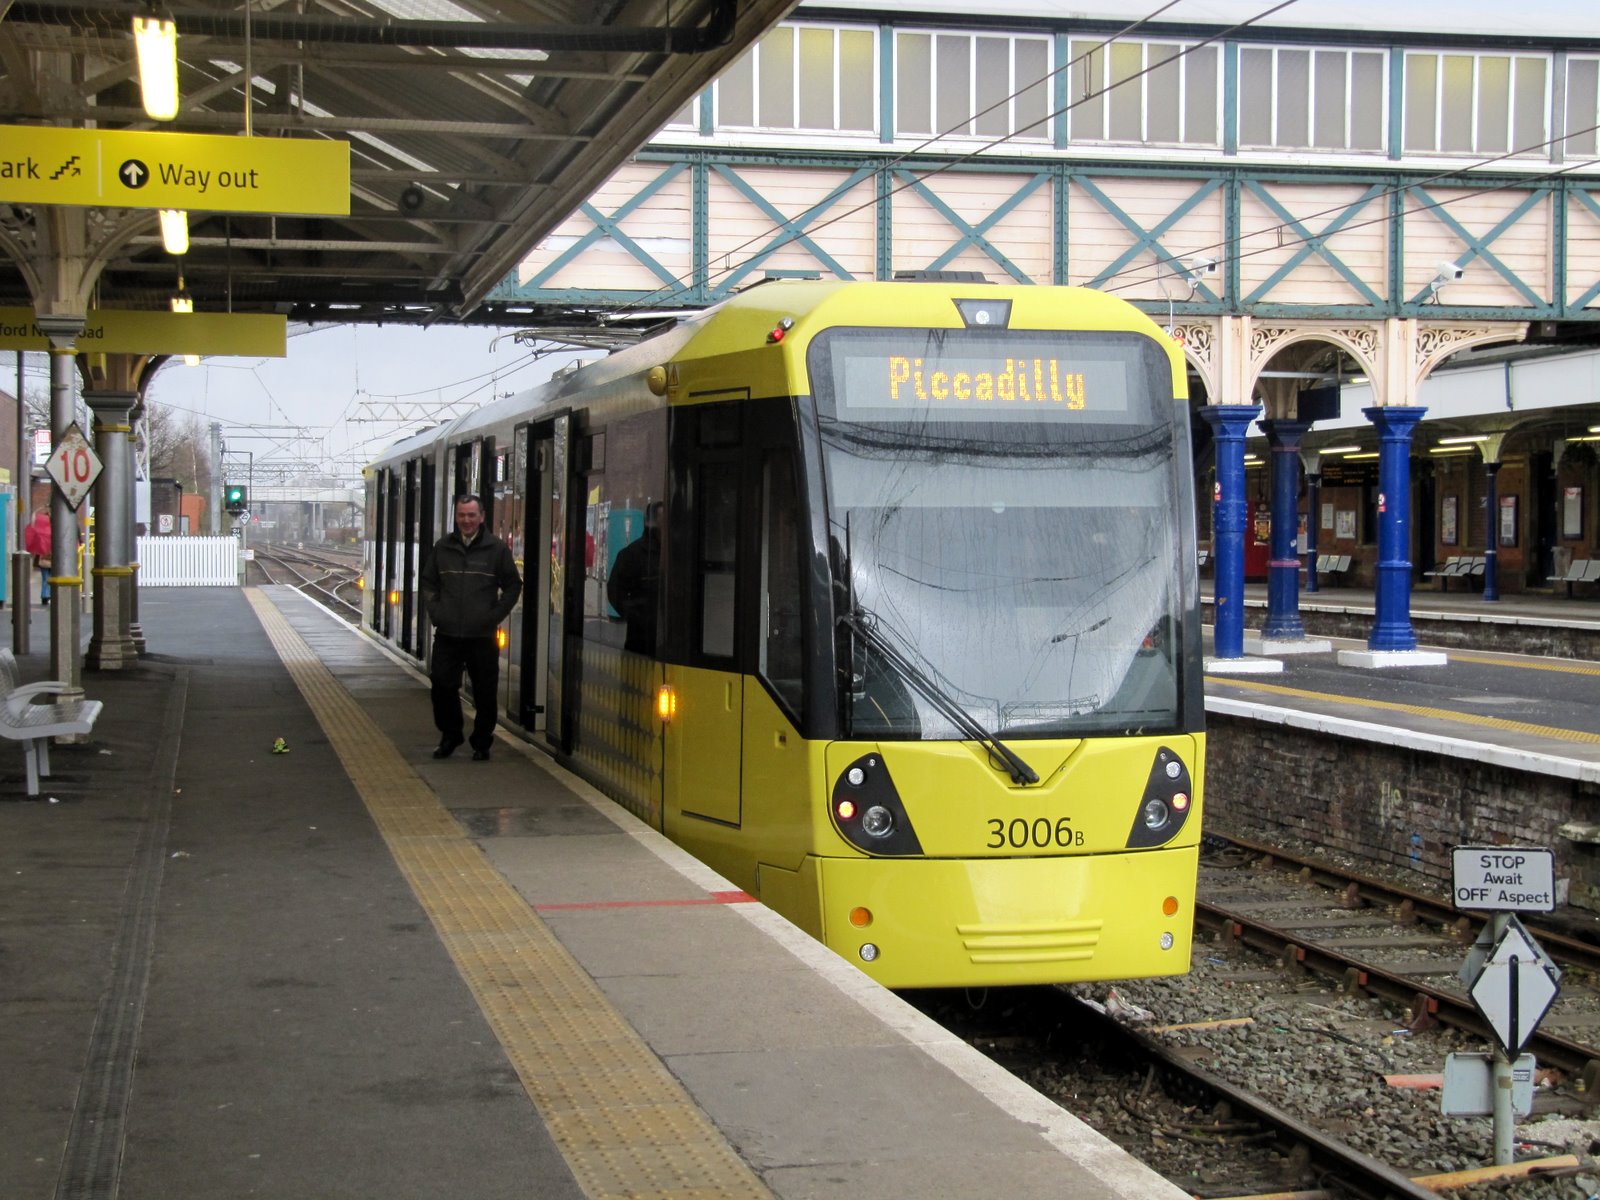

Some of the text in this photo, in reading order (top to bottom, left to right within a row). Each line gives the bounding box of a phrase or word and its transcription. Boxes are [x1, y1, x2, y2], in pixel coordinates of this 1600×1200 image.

[1, 156, 40, 180] ark
[159, 162, 259, 193] Way out
[77, 325, 104, 339] oad
[888, 355, 1087, 410] Piccadilly
[60, 447, 91, 483] 10
[1480, 855, 1526, 869] STOP
[1483, 871, 1523, 886] Await
[1498, 890, 1550, 906] Aspect
